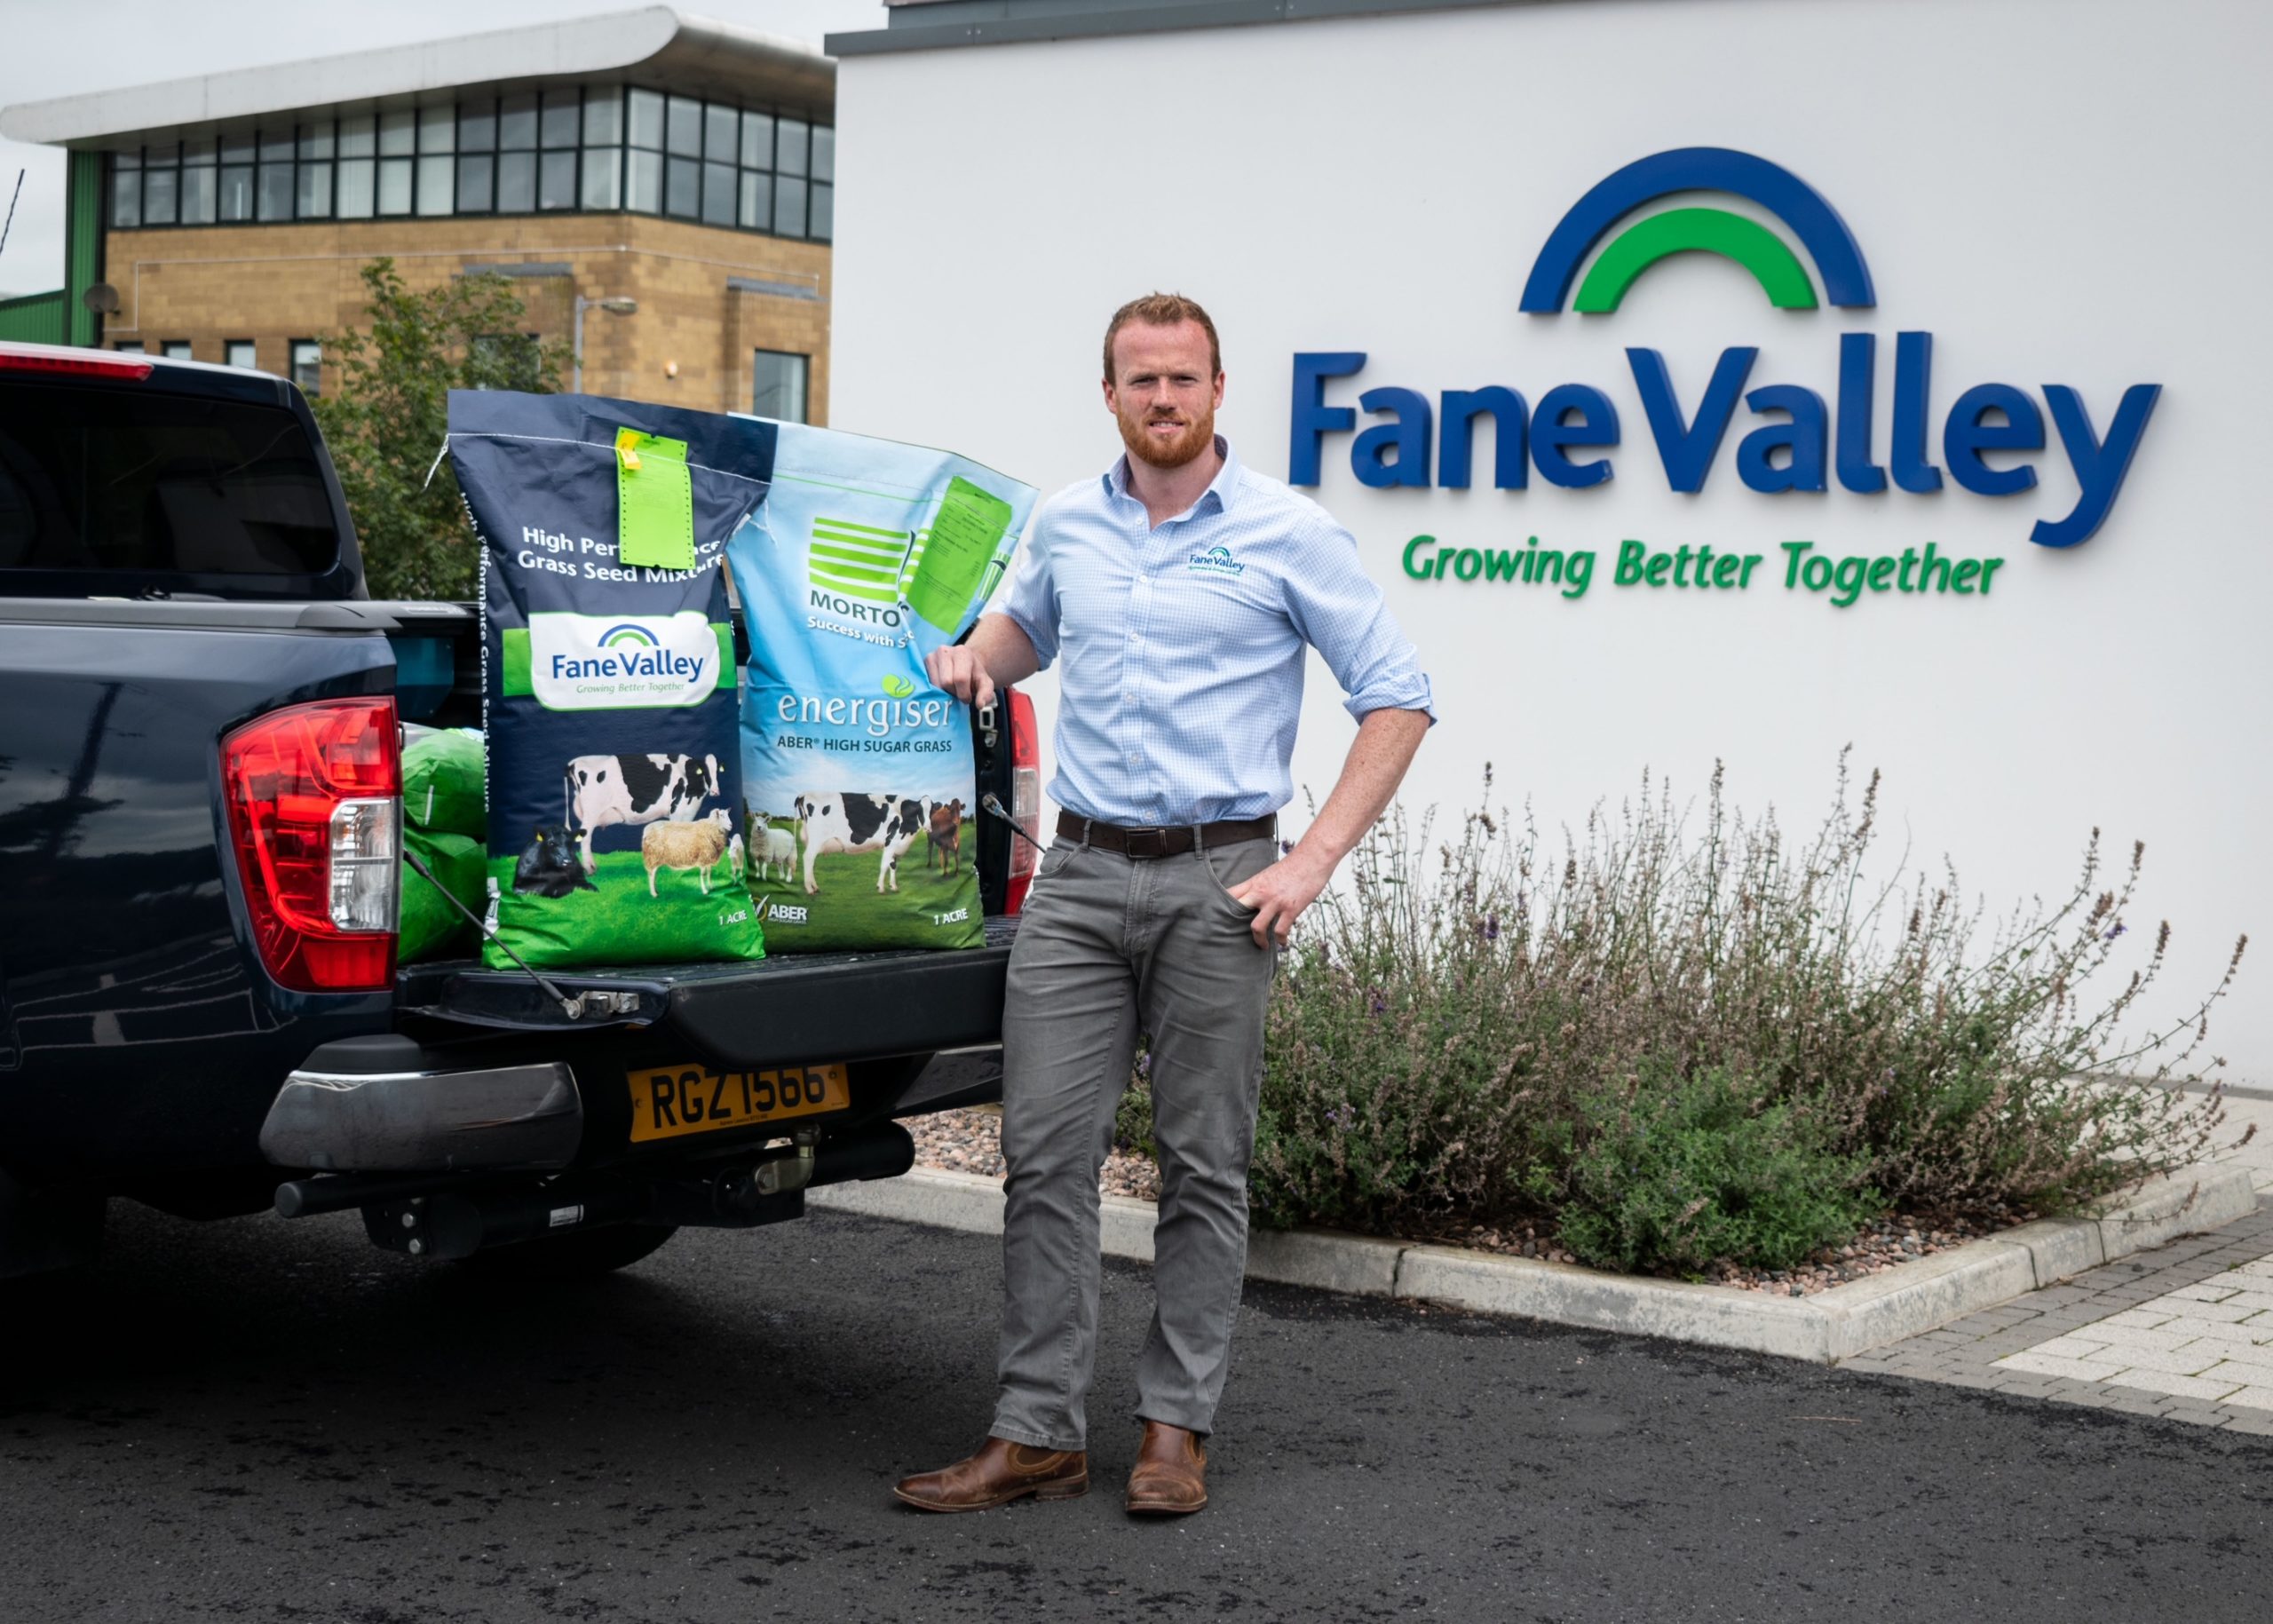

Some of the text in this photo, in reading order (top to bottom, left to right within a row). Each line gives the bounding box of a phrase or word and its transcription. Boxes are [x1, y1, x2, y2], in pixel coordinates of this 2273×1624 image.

[522, 526, 574, 553] High
[518, 550, 577, 576] Grass
[583, 561, 638, 582] Seed
[1401, 535, 2006, 609] Growing Better Together
[807, 616, 861, 639] Success
[863, 631, 895, 648] with
[576, 681, 685, 695] Growing Better Together
[777, 693, 954, 737] energiser
[823, 739, 860, 752] HIGH
[863, 740, 911, 753] SUGAR
[914, 741, 952, 753] GRASS
[718, 915, 724, 925] 1
[767, 903, 807, 921] ABER
[933, 907, 970, 926] 1 ACRE
